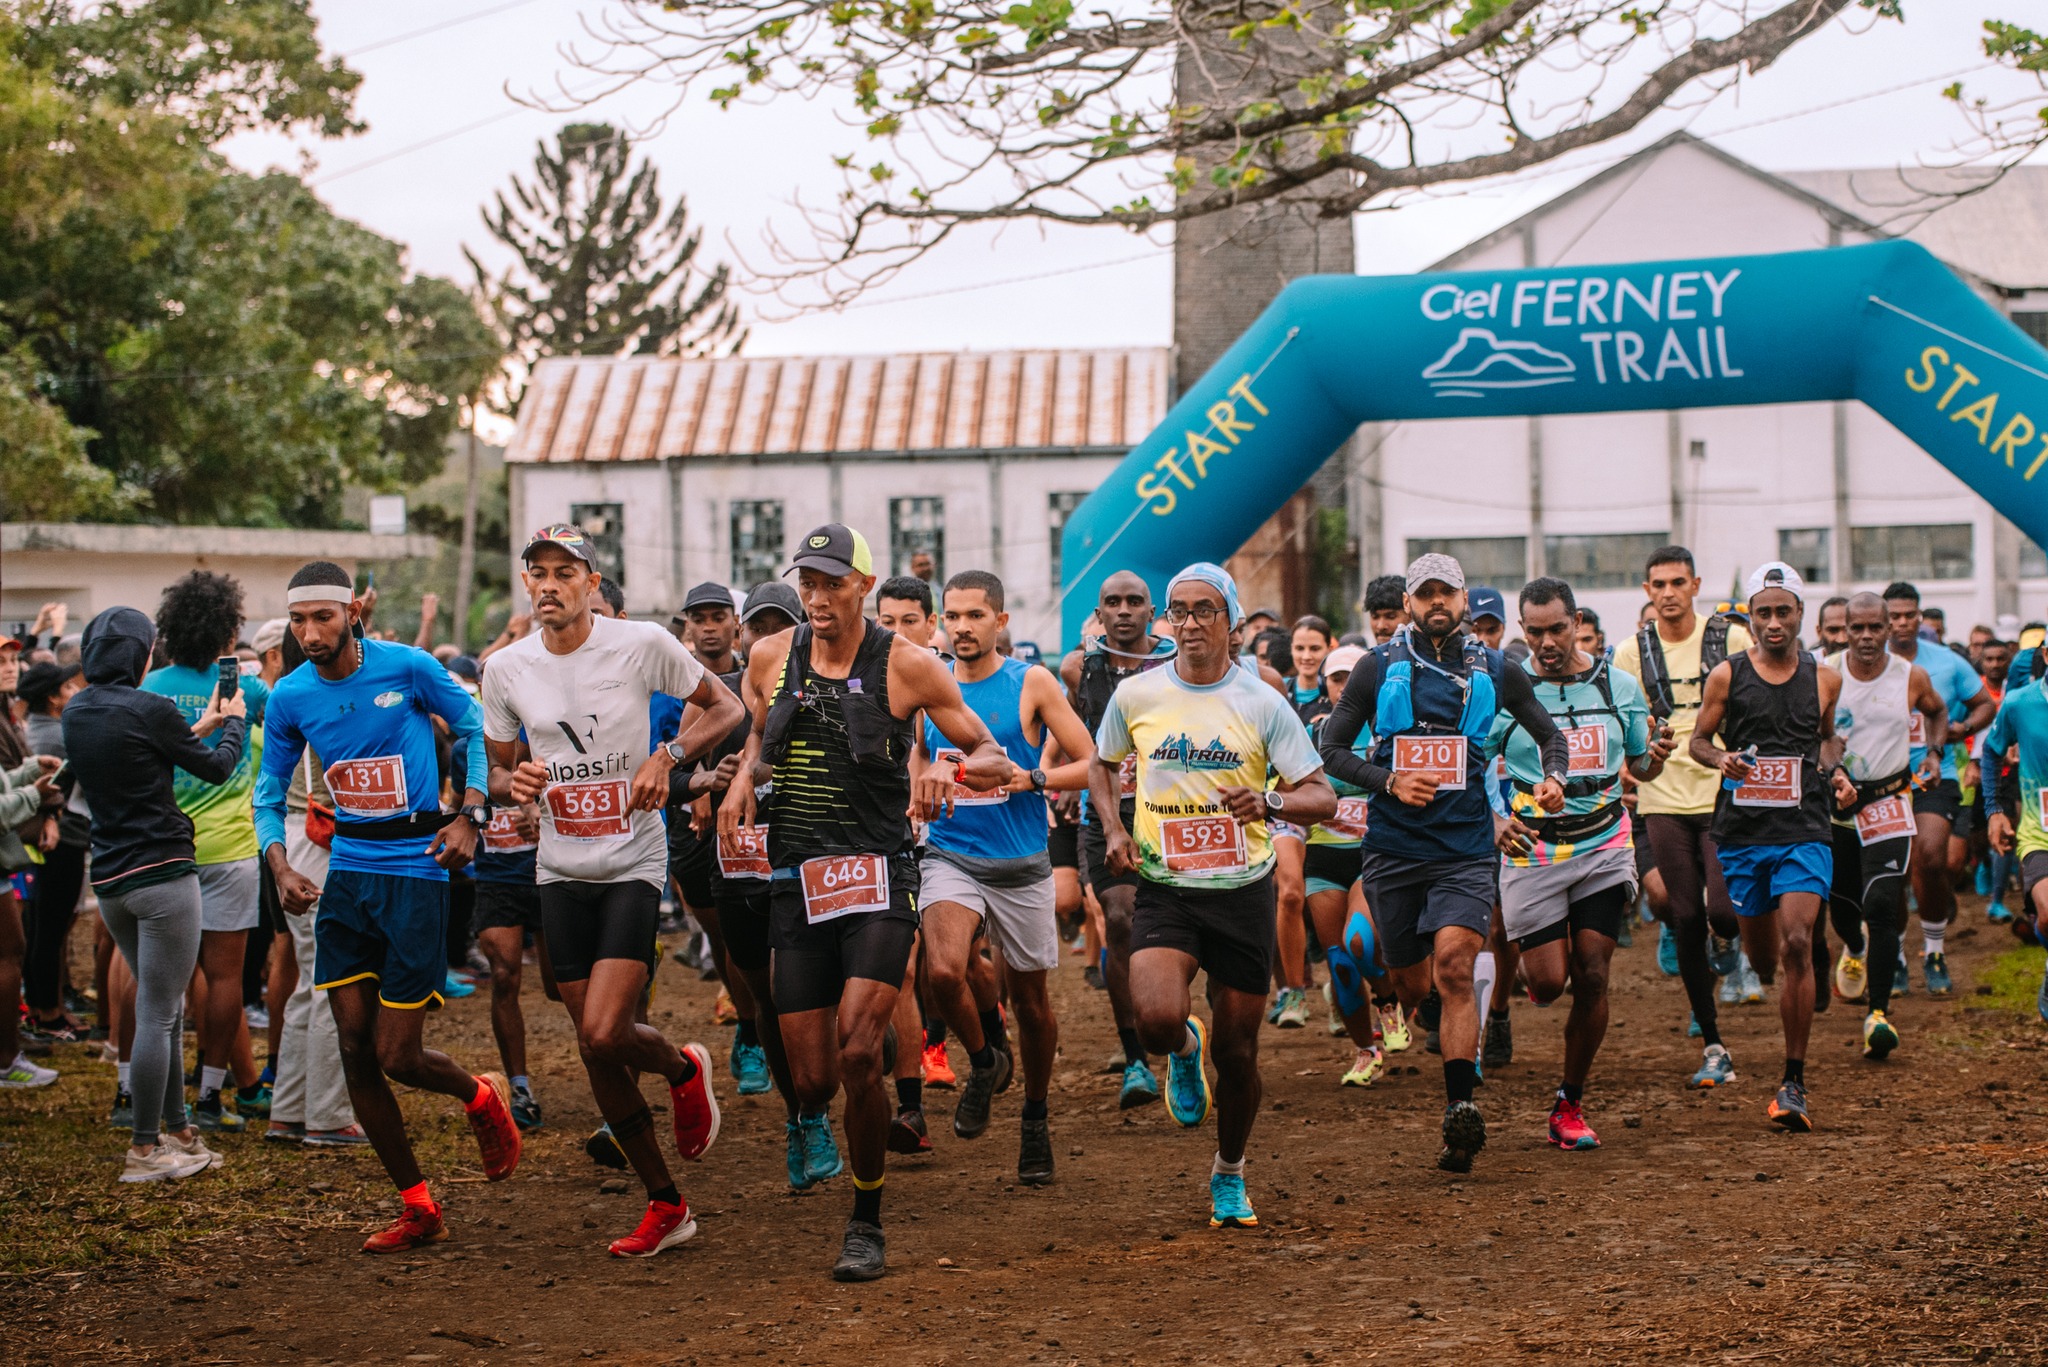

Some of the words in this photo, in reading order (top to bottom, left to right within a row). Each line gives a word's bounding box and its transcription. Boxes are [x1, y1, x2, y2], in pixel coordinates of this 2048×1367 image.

[1420, 283, 1501, 321] Ciel
[1511, 269, 1742, 328] FERNEY
[1579, 326, 1745, 384] TRAIL
[1903, 345, 2048, 482] START
[1136, 373, 1270, 516] START
[1567, 732, 1593, 751] 50
[1410, 745, 1451, 764] 210
[344, 767, 383, 788] 131
[1750, 765, 1787, 782] 332
[565, 790, 611, 814] 563
[1184, 804, 1195, 814] IS
[1198, 804, 1219, 814] OUR
[1867, 804, 1898, 822] 381
[490, 814, 515, 832] 64
[1182, 824, 1227, 848] 593
[823, 861, 867, 887] 646
